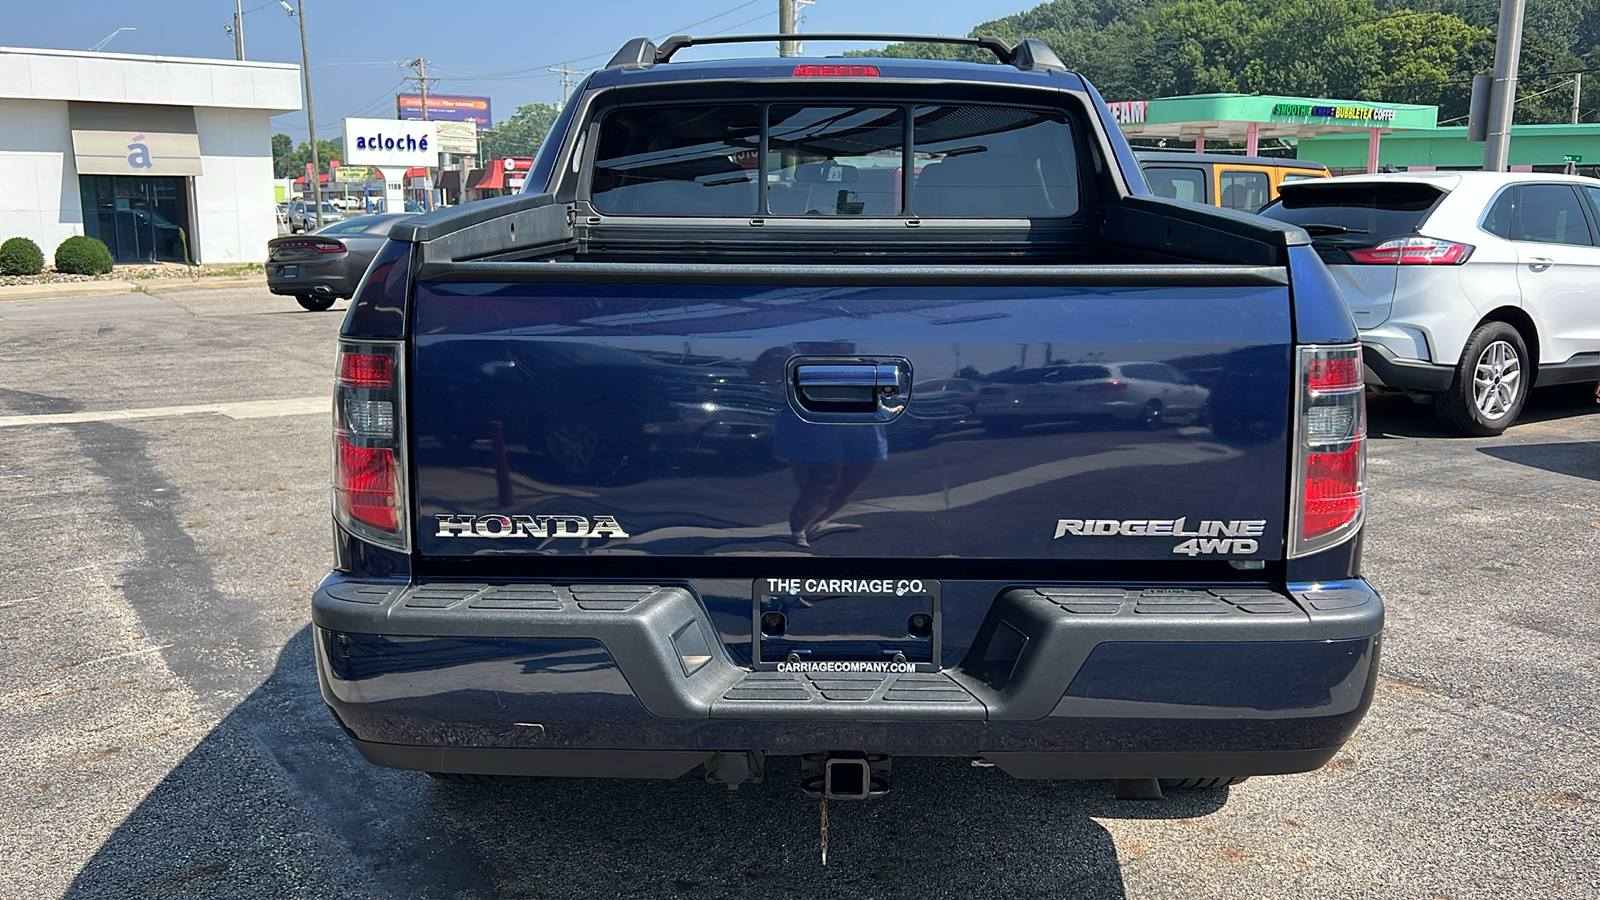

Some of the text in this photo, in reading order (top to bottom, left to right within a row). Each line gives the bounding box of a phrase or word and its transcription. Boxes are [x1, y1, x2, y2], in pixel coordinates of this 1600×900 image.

[1110, 101, 1144, 123] EAM
[1372, 108, 1396, 121] COFFEE
[127, 134, 153, 169] á
[356, 133, 428, 151] acloché
[434, 514, 630, 538] HONDA
[1053, 516, 1267, 540] RIDGELINE
[1173, 538, 1259, 557] 4WD
[767, 578, 927, 593] THE CARRIAGE CO.
[777, 661, 916, 673] CARRIAGECOMPANY.COM
